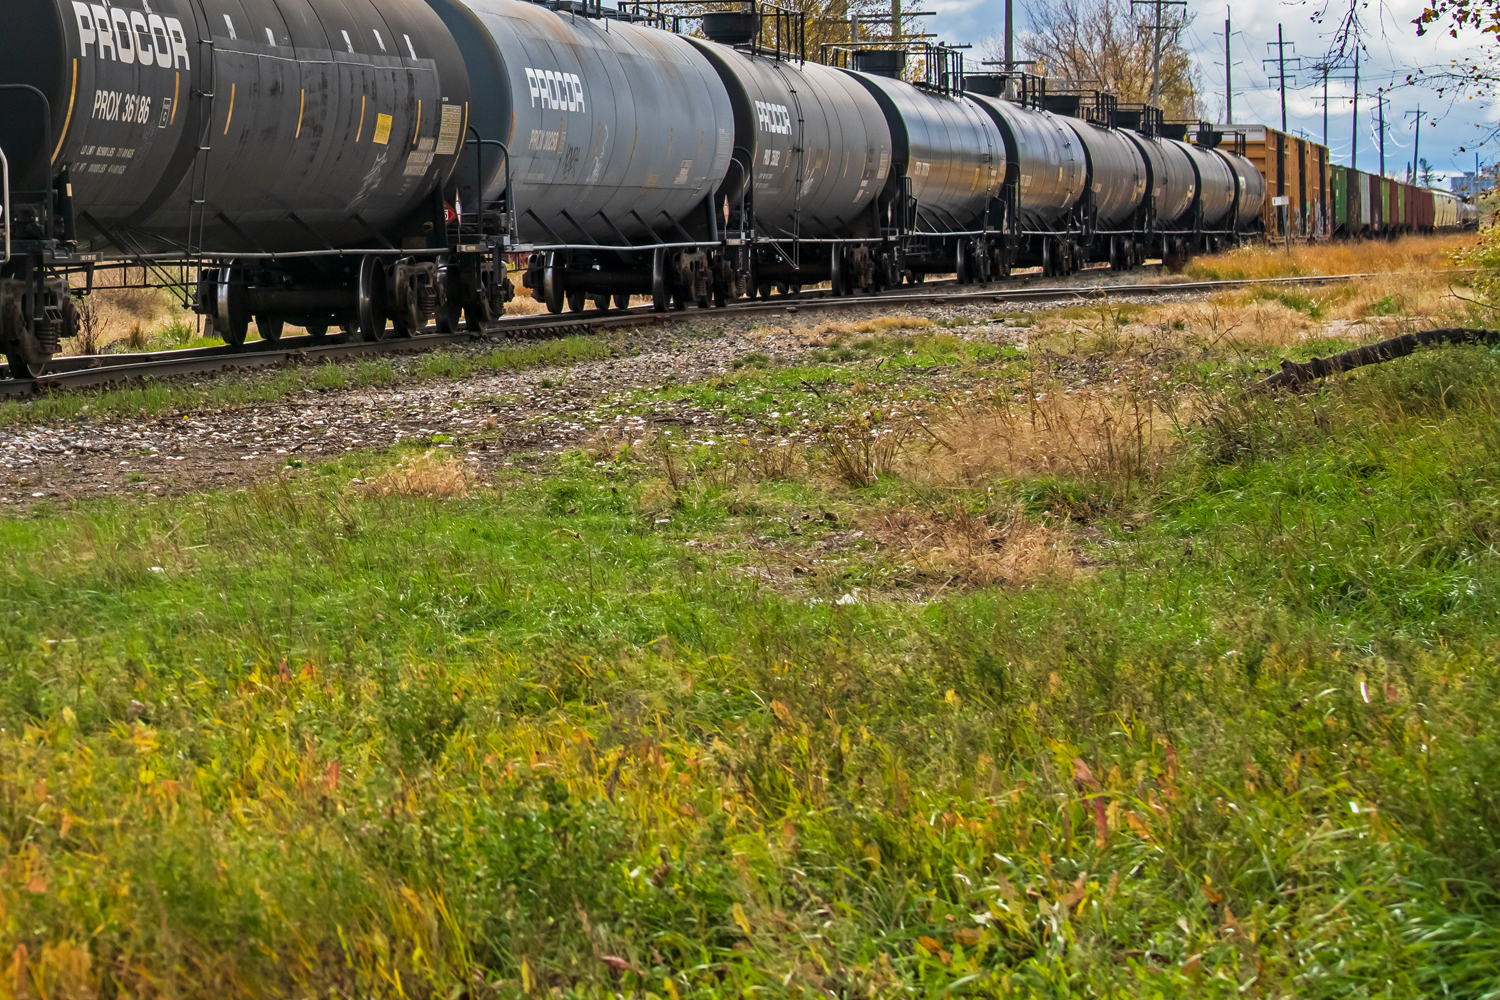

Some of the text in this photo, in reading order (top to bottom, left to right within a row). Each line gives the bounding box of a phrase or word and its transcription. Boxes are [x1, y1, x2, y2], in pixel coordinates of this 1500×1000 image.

[71, 0, 191, 71] PROCOR
[91, 89, 151, 125] PROX 36186
[524, 67, 586, 114] PROCOR
[755, 100, 792, 135] PROCOR
